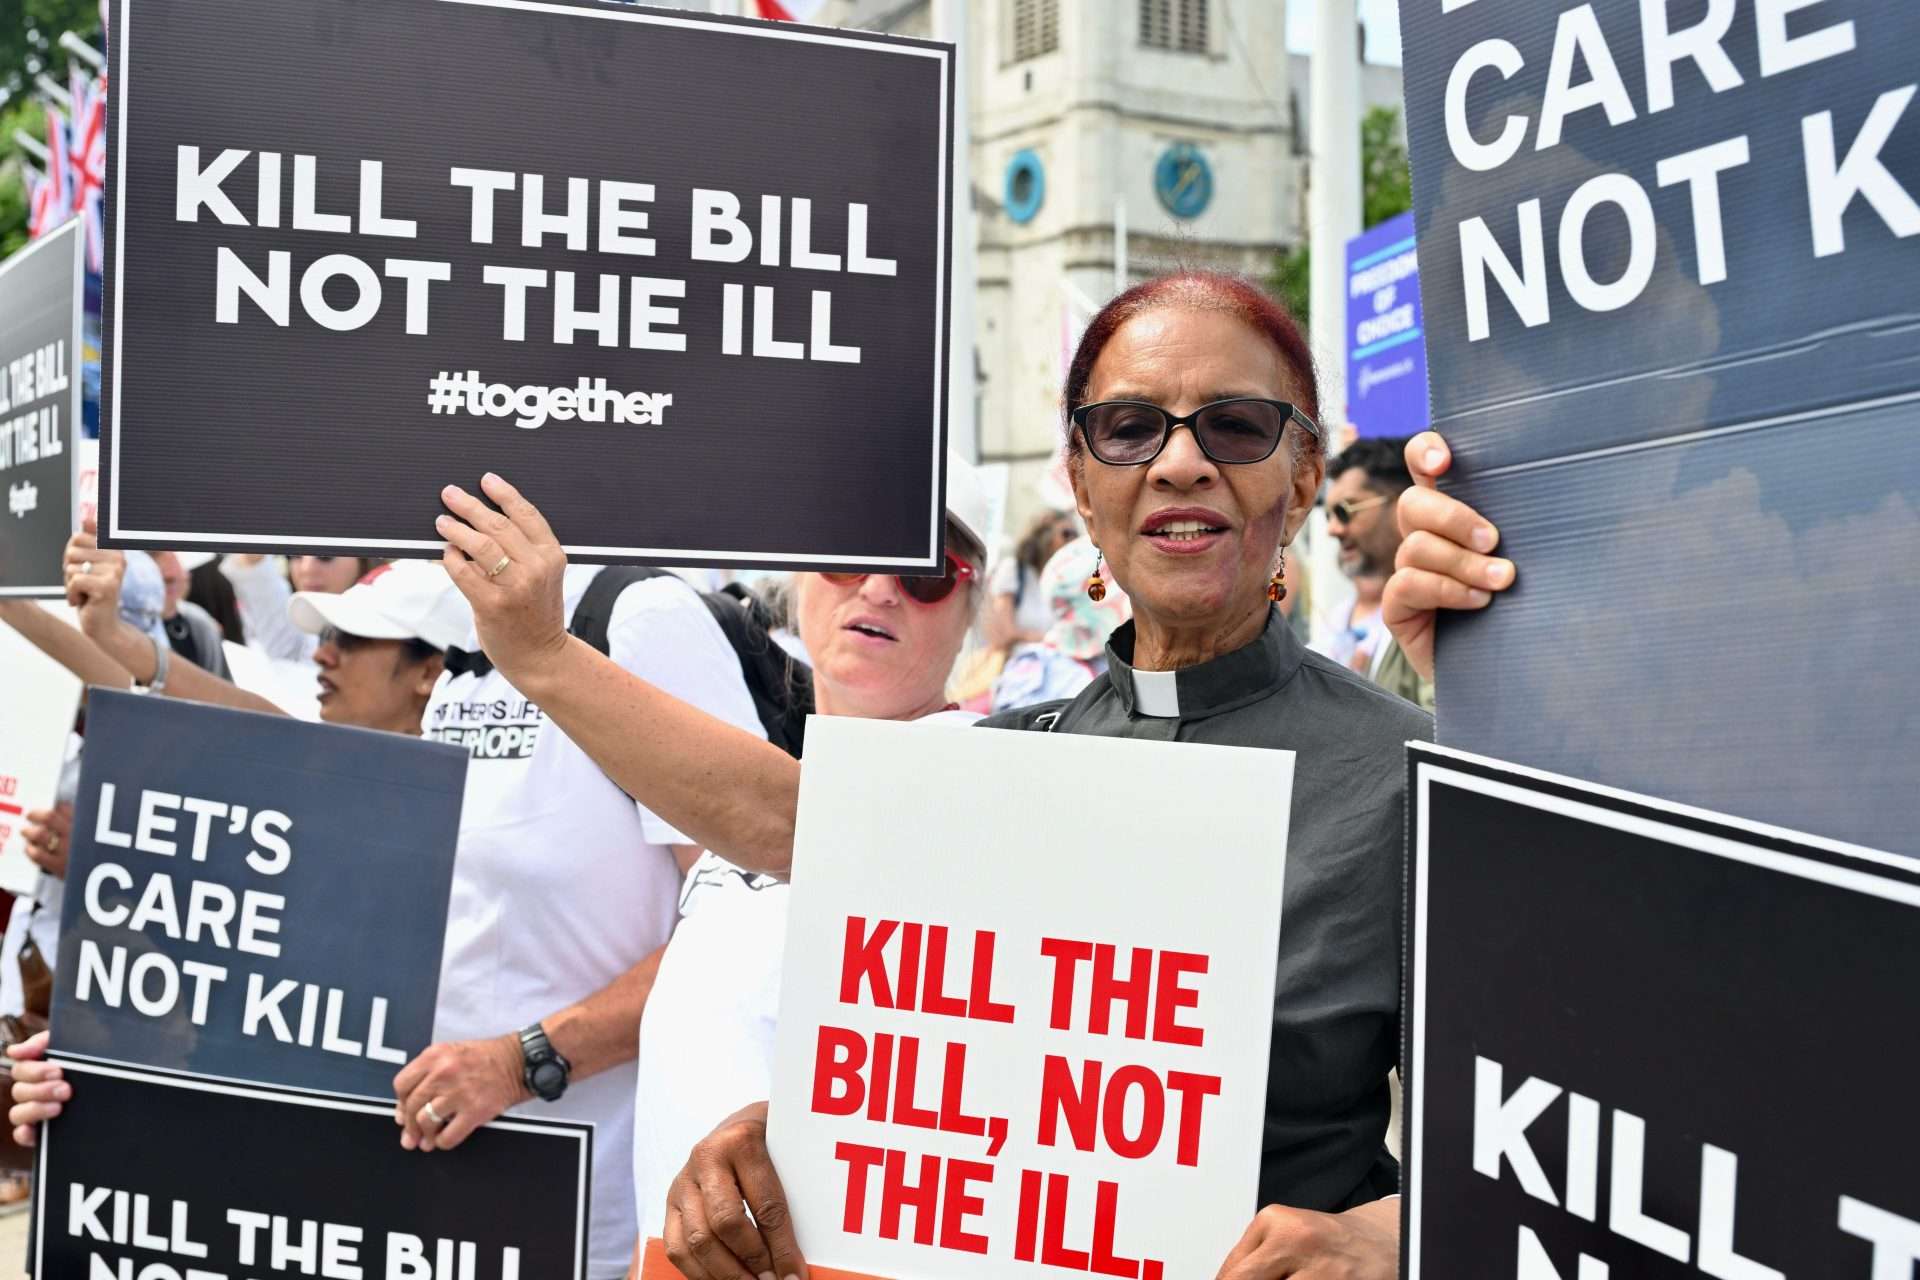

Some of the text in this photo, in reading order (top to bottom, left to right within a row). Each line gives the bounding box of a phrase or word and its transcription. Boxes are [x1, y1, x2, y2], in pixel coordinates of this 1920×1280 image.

[1443, 0, 1857, 171] CARE
[176, 145, 898, 277] KILL THE BILL
[1458, 135, 1750, 342] NOT
[215, 246, 862, 364] NOT THE ILL
[427, 369, 673, 430] #together
[95, 782, 293, 876] LET'S
[85, 862, 286, 958] CARE
[75, 939, 408, 1065] NOT KILL
[839, 915, 1210, 1048] KILL THE
[810, 1024, 1222, 1168] BILL, NOT
[69, 1182, 208, 1259] KILL
[226, 1208, 364, 1280] THE
[834, 1141, 1165, 1280] THE ILL.
[1472, 1055, 1787, 1280] KILL
